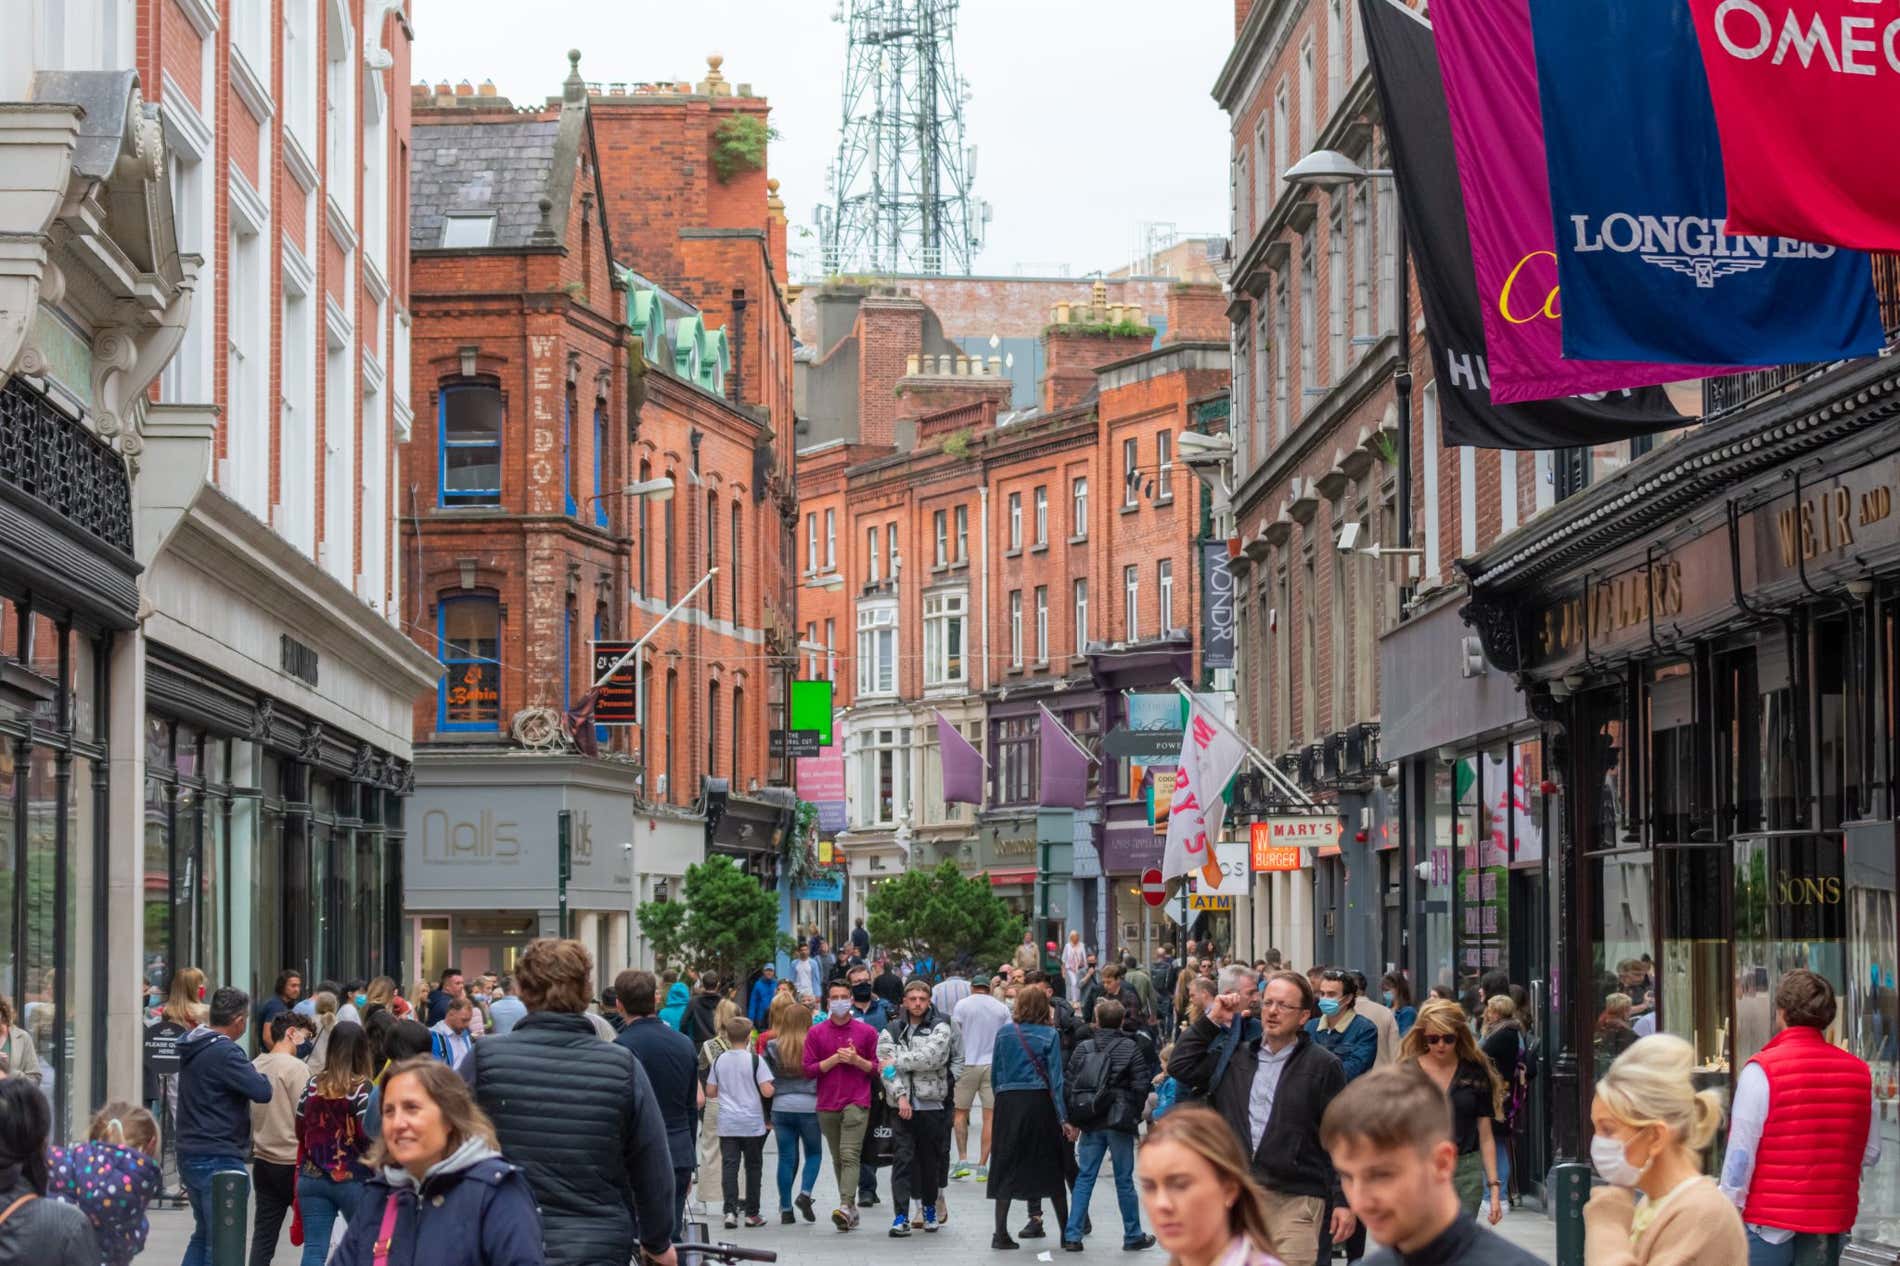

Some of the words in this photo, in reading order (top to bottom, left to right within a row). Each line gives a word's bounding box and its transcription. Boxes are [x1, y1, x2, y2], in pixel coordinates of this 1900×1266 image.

[1778, 485, 1854, 568] WEIR
[1859, 486, 1891, 527] AND
[1211, 551, 1233, 642] WONDR
[1173, 714, 1217, 855] MRY'S
[1273, 823, 1334, 837] MARY'S
[1255, 851, 1296, 867] BURGER
[1194, 895, 1230, 909] ATM
